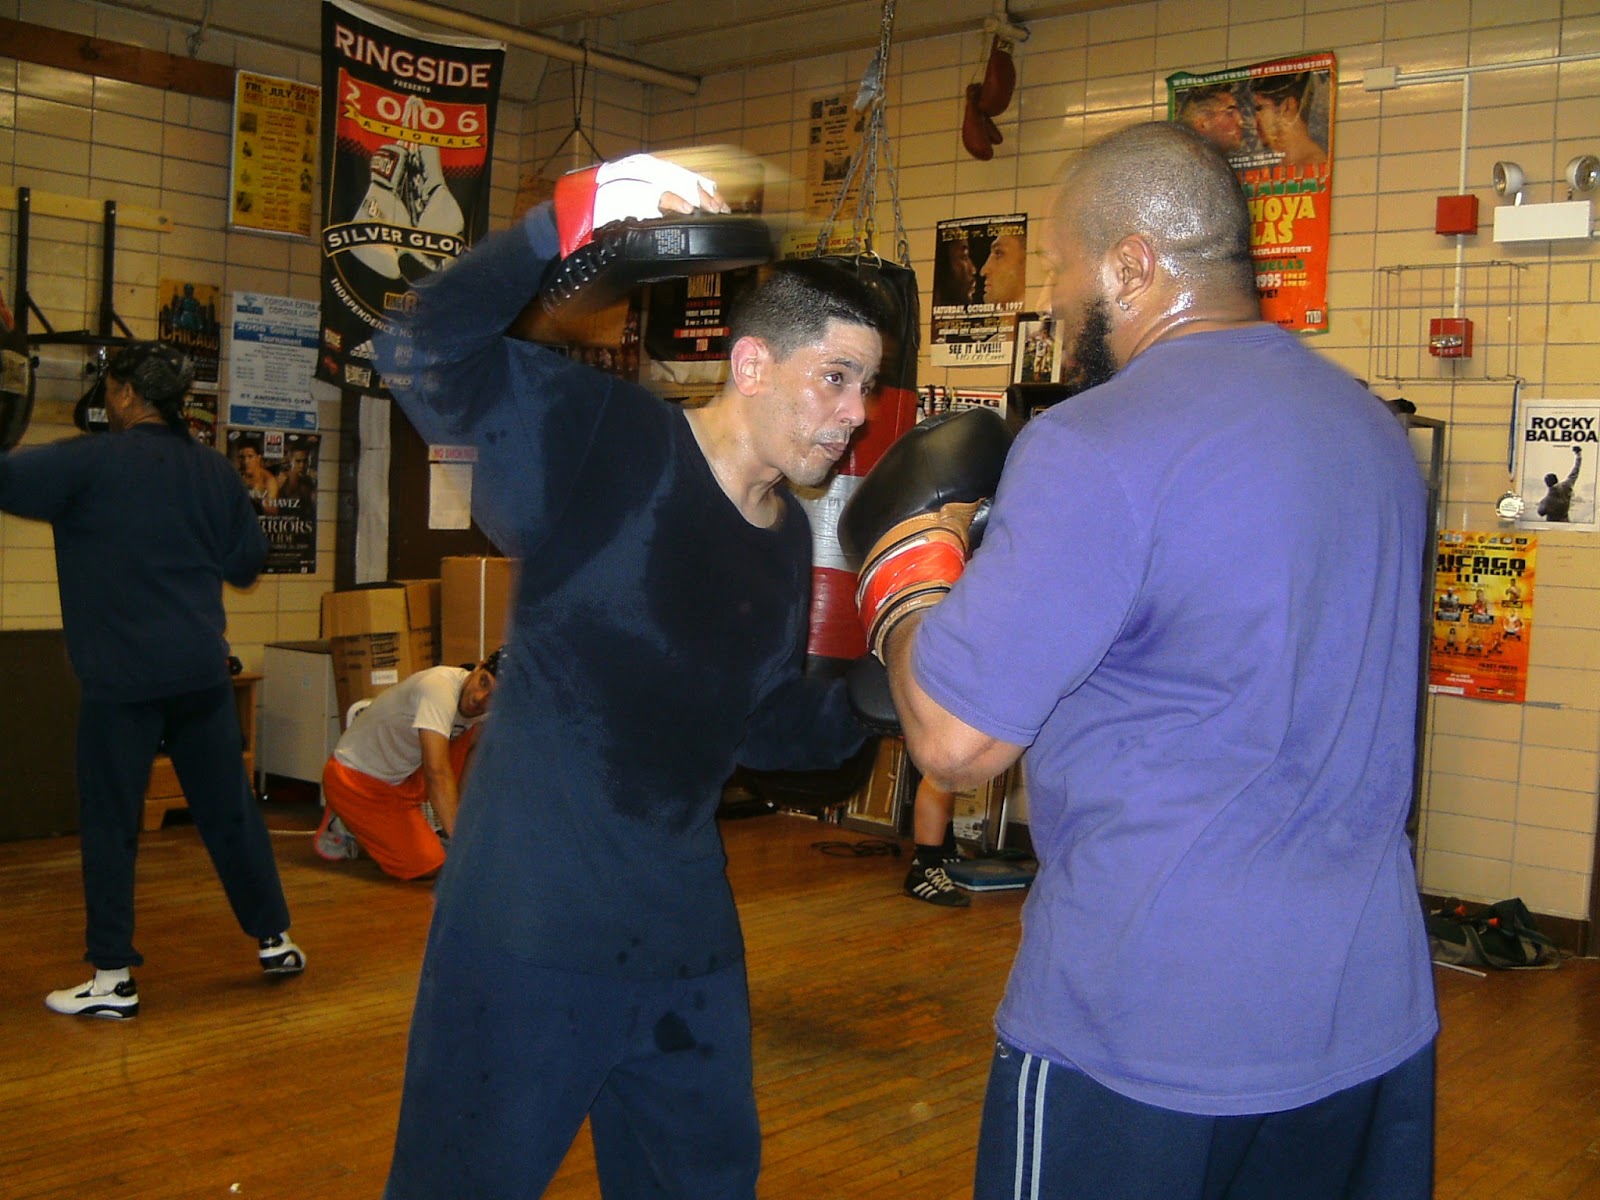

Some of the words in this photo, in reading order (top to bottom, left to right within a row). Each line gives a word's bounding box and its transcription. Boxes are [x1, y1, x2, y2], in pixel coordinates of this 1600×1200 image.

[335, 23, 491, 88] RINGSIDE
[393, 78, 431, 93] PRESENTS
[354, 112, 473, 146] ATIONAL
[1248, 196, 1316, 222] HOYA
[328, 226, 402, 248] SILVER
[409, 233, 463, 255] GLOV
[1250, 248, 1281, 256] ACULAR
[1282, 246, 1312, 254] FIGHTS
[1256, 273, 1282, 288] 1995
[1259, 289, 1278, 298] VE!
[331, 278, 396, 336] INDEPENDENCE,
[933, 304, 966, 315] SATURDAY,
[967, 303, 995, 313] OCTOBER
[1006, 302, 1023, 311] 1997
[160, 321, 219, 351] CHICAGO
[949, 344, 962, 354] SEE
[965, 344, 973, 354] IT
[975, 342, 1002, 354] LIVE!!!
[1531, 417, 1595, 429] ROCKY
[1525, 430, 1598, 442] BALBOA
[262, 498, 300, 508] CHAVEZ
[260, 517, 313, 534] RRIORS
[1472, 567, 1523, 577] NIGHT
